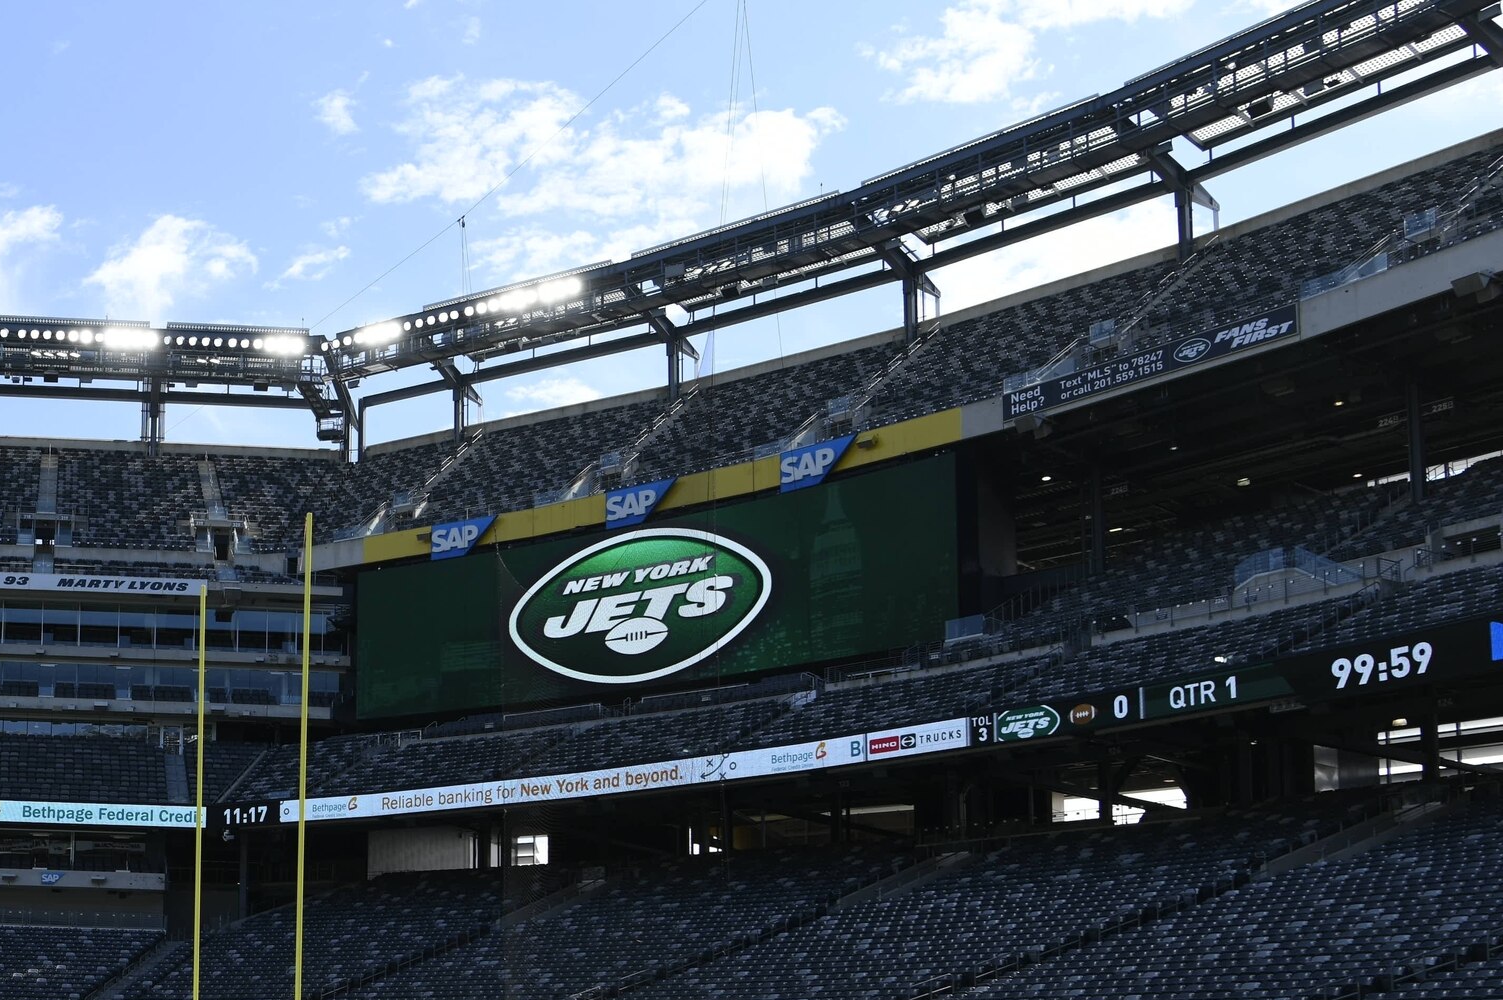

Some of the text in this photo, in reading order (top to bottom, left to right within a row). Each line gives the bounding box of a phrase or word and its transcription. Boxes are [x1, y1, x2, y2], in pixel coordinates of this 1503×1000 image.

[1214, 317, 1269, 344] FANS
[1230, 320, 1293, 349] FIRST
[1179, 342, 1207, 358] JETS
[1060, 377, 1082, 390] Text
[1118, 360, 1130, 372] to
[1131, 350, 1163, 368] 78247
[1060, 361, 1163, 399] or call 201.559.1515
[1010, 386, 1041, 404] Need
[1011, 396, 1045, 416] Help?
[780, 448, 835, 484] SAP
[606, 489, 656, 521] SAP
[431, 525, 479, 553] SAP
[3, 576, 189, 592] 93 MARTY LYONS
[562, 555, 715, 596] NEW YORK
[543, 575, 735, 638] JETS
[1331, 642, 1433, 689] 99:59
[1169, 676, 1238, 709] QTR 1
[1005, 713, 1026, 721] NEW
[1113, 695, 1129, 719] 0
[971, 716, 992, 727] TOL
[1000, 716, 1051, 734] JETS
[871, 729, 962, 750] HINO TRUCKS
[978, 727, 989, 742] 3
[771, 751, 814, 764] Bethpage
[850, 740, 863, 757] B
[381, 765, 683, 810] Reliable banking for New York and beyond.
[22, 805, 93, 823] Bethpage
[98, 808, 153, 822] Federal
[223, 805, 268, 825] 11:17
[312, 802, 347, 812] Bethpage
[41, 873, 61, 882] SAP
